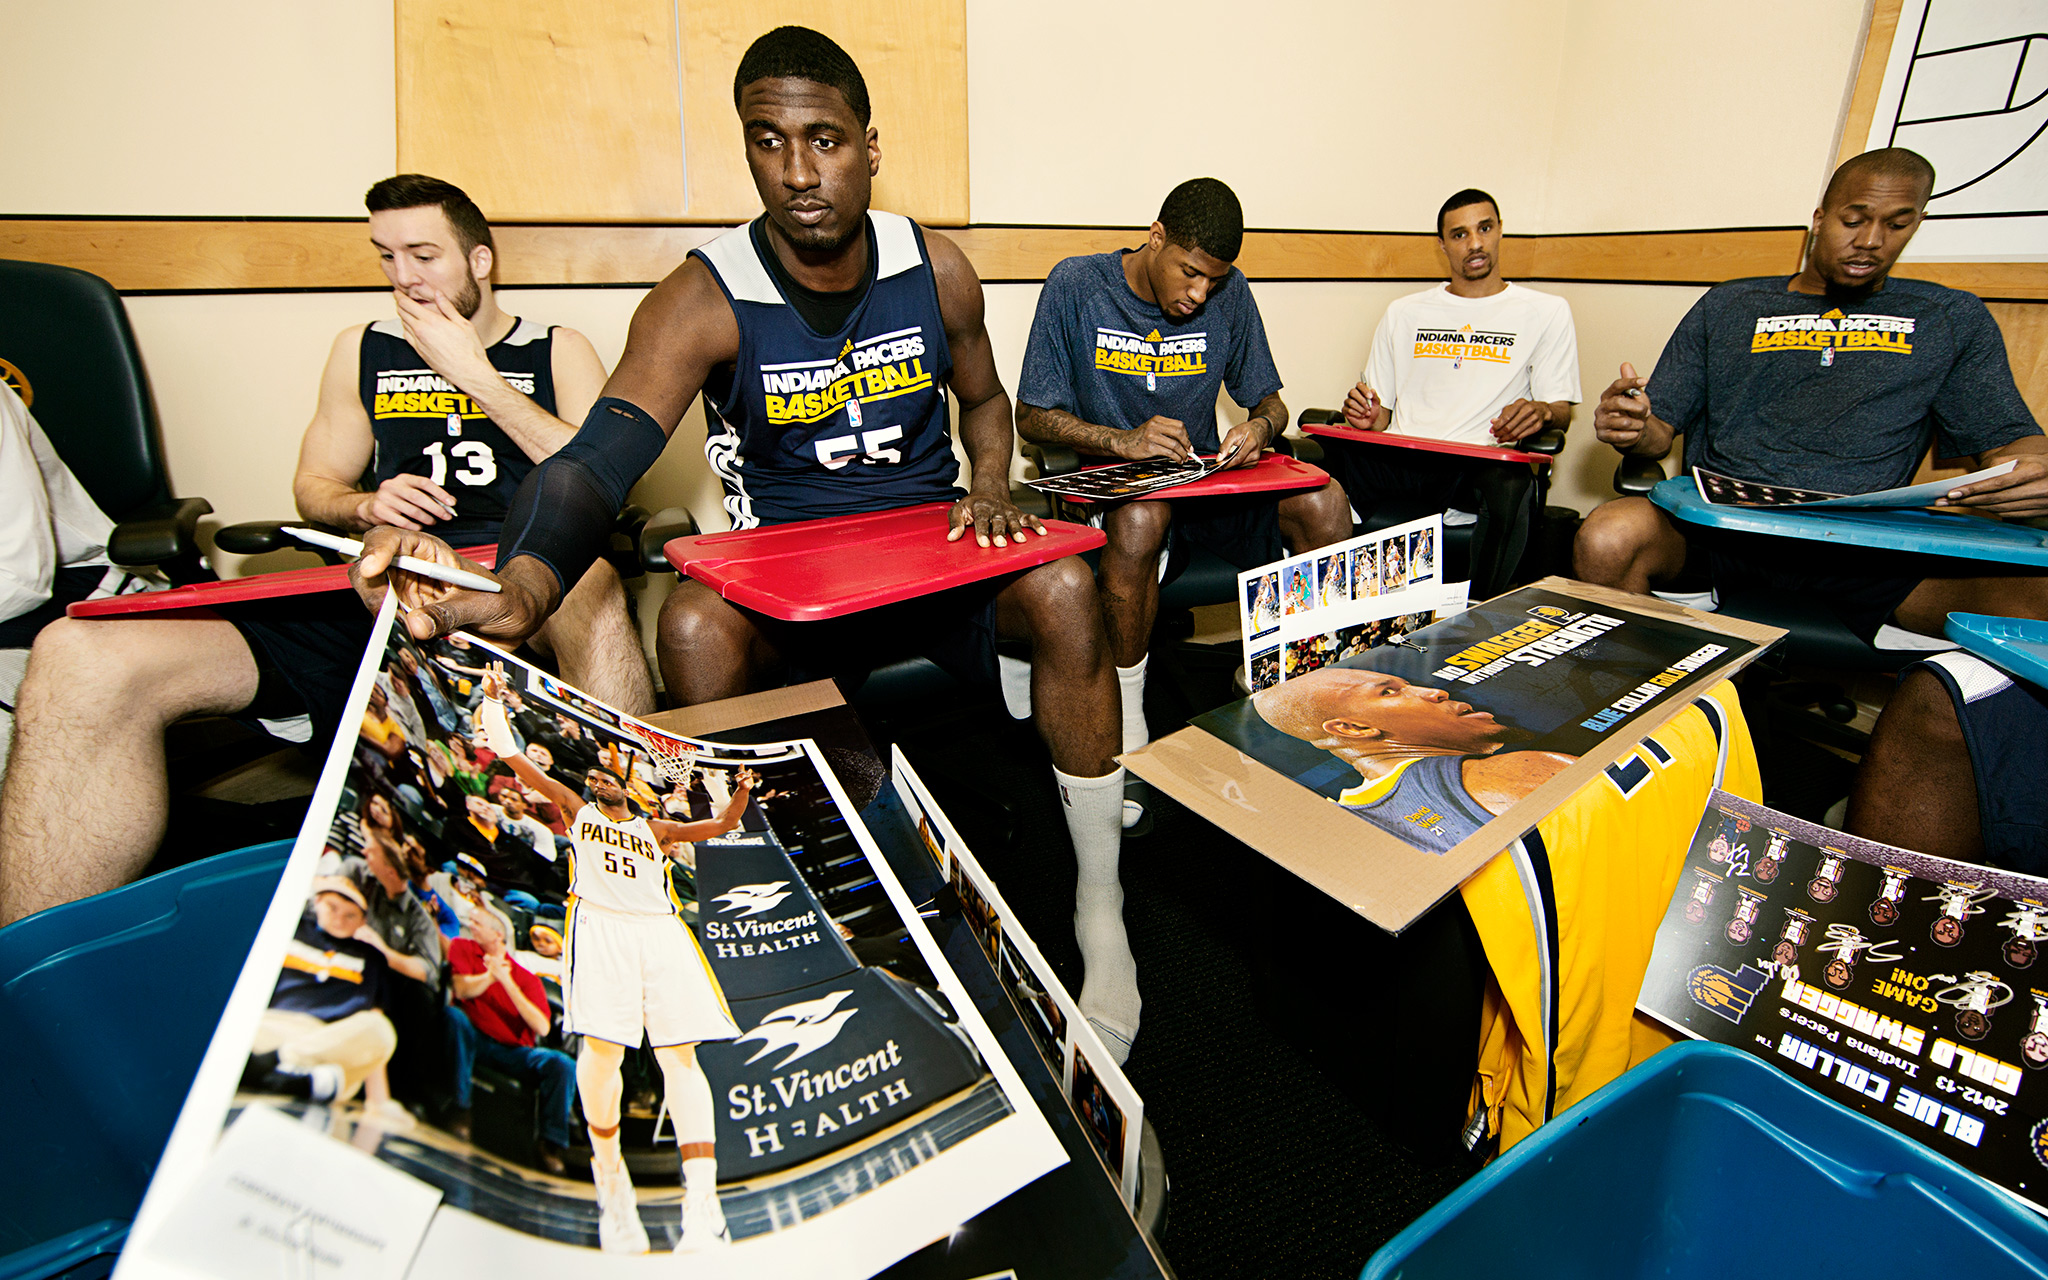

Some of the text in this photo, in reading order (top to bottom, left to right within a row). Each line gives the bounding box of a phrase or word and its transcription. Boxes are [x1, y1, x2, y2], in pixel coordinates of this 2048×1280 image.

[1415, 332, 1515, 347] INDIANA PACERS
[1751, 331, 1913, 350] BASKETBALL
[1755, 318, 1915, 334] INDIANA PACERS
[1095, 347, 1207, 372] BASKETBALL
[1097, 333, 1207, 356] INDIANA PACERS
[1413, 342, 1511, 360] BASKETBALL
[762, 335, 926, 394] INDIANA PACERS
[376, 375, 458, 394] INDIANA
[765, 357, 932, 420] BASKETBALL
[373, 391, 482, 414] BASKET
[814, 424, 904, 471] 55
[422, 440, 498, 487] 13
[1431, 618, 1562, 682] NO SWAGGER
[1458, 613, 1626, 686] WITHOUT STRENGTH
[1580, 707, 1628, 733] BLUE
[1610, 682, 1667, 713] COLLAR
[1648, 666, 1690, 688] GOLD
[1404, 805, 1432, 824] David
[1416, 812, 1444, 830] West
[581, 822, 655, 862] PACERS
[1429, 825, 1446, 837] 21
[604, 850, 637, 880] 55
[715, 931, 821, 958] HEALTH
[1890, 967, 1930, 992] ON!
[1871, 978, 1939, 1014] GAME
[1780, 978, 1927, 1057] SWAGGER
[1778, 1006, 2010, 1116] 2012-13 Indiana Pacers
[1929, 1037, 2024, 1097] GOLD
[1754, 1030, 1986, 1148] BLUE COLLAR TM
